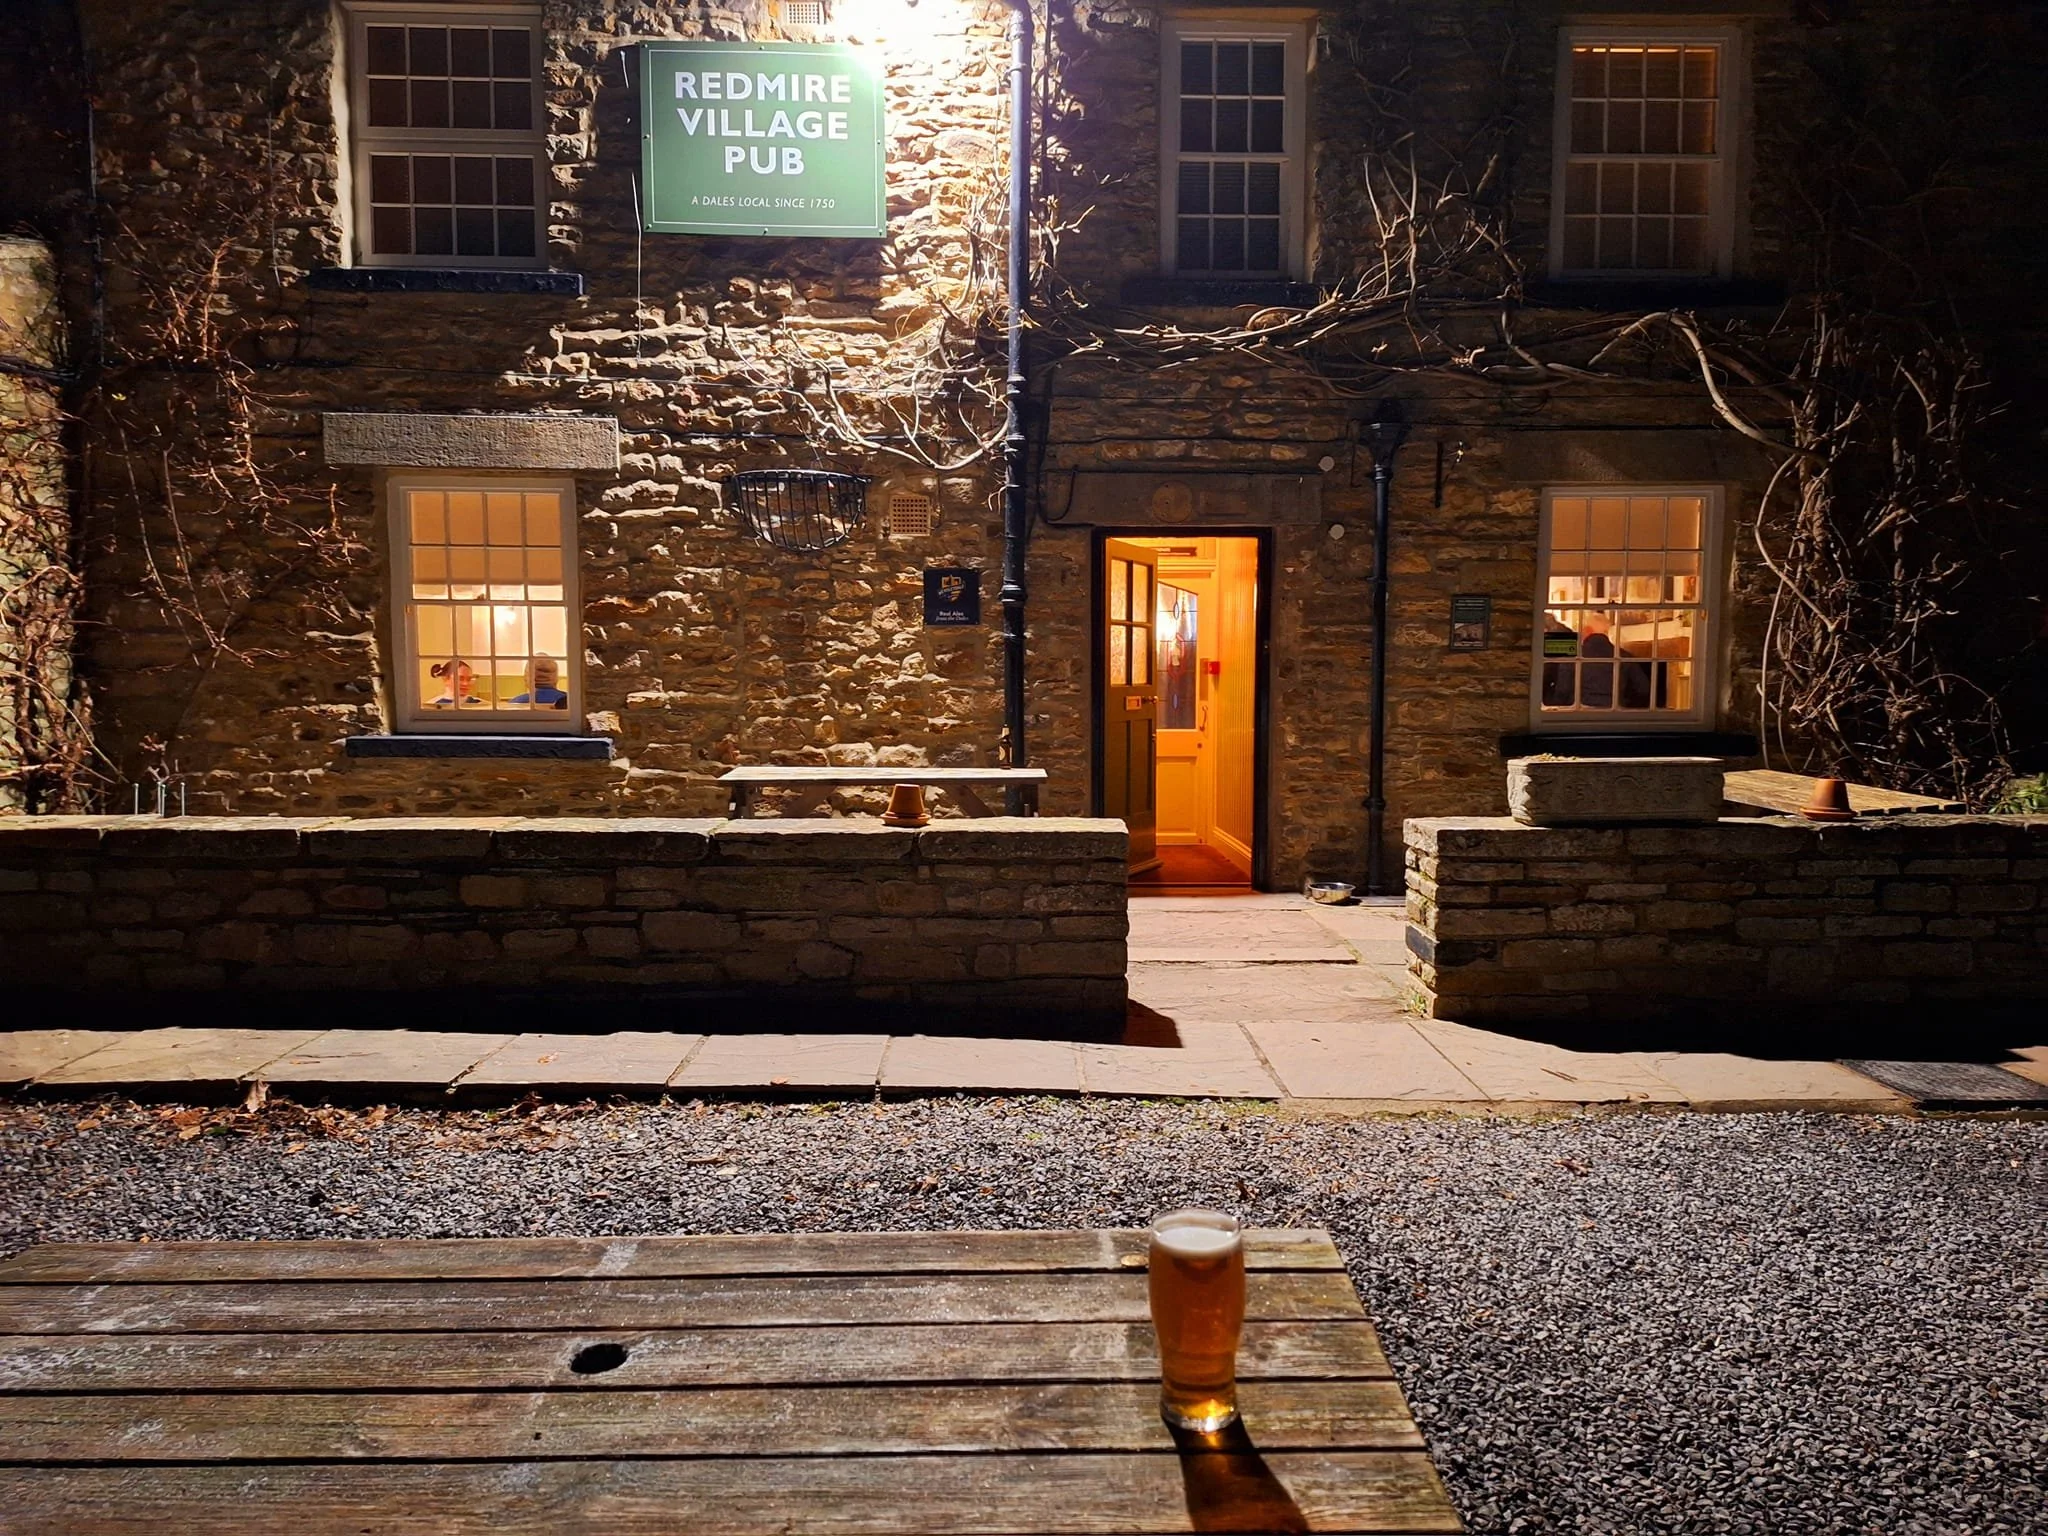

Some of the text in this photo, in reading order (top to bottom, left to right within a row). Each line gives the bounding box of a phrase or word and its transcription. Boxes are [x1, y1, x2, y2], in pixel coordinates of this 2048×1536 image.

[674, 71, 852, 104] REDMIRE
[677, 107, 849, 140] VILLAGE
[724, 145, 805, 175] PUB
[691, 195, 835, 209] A DALES LOCAL SINCE 1750
